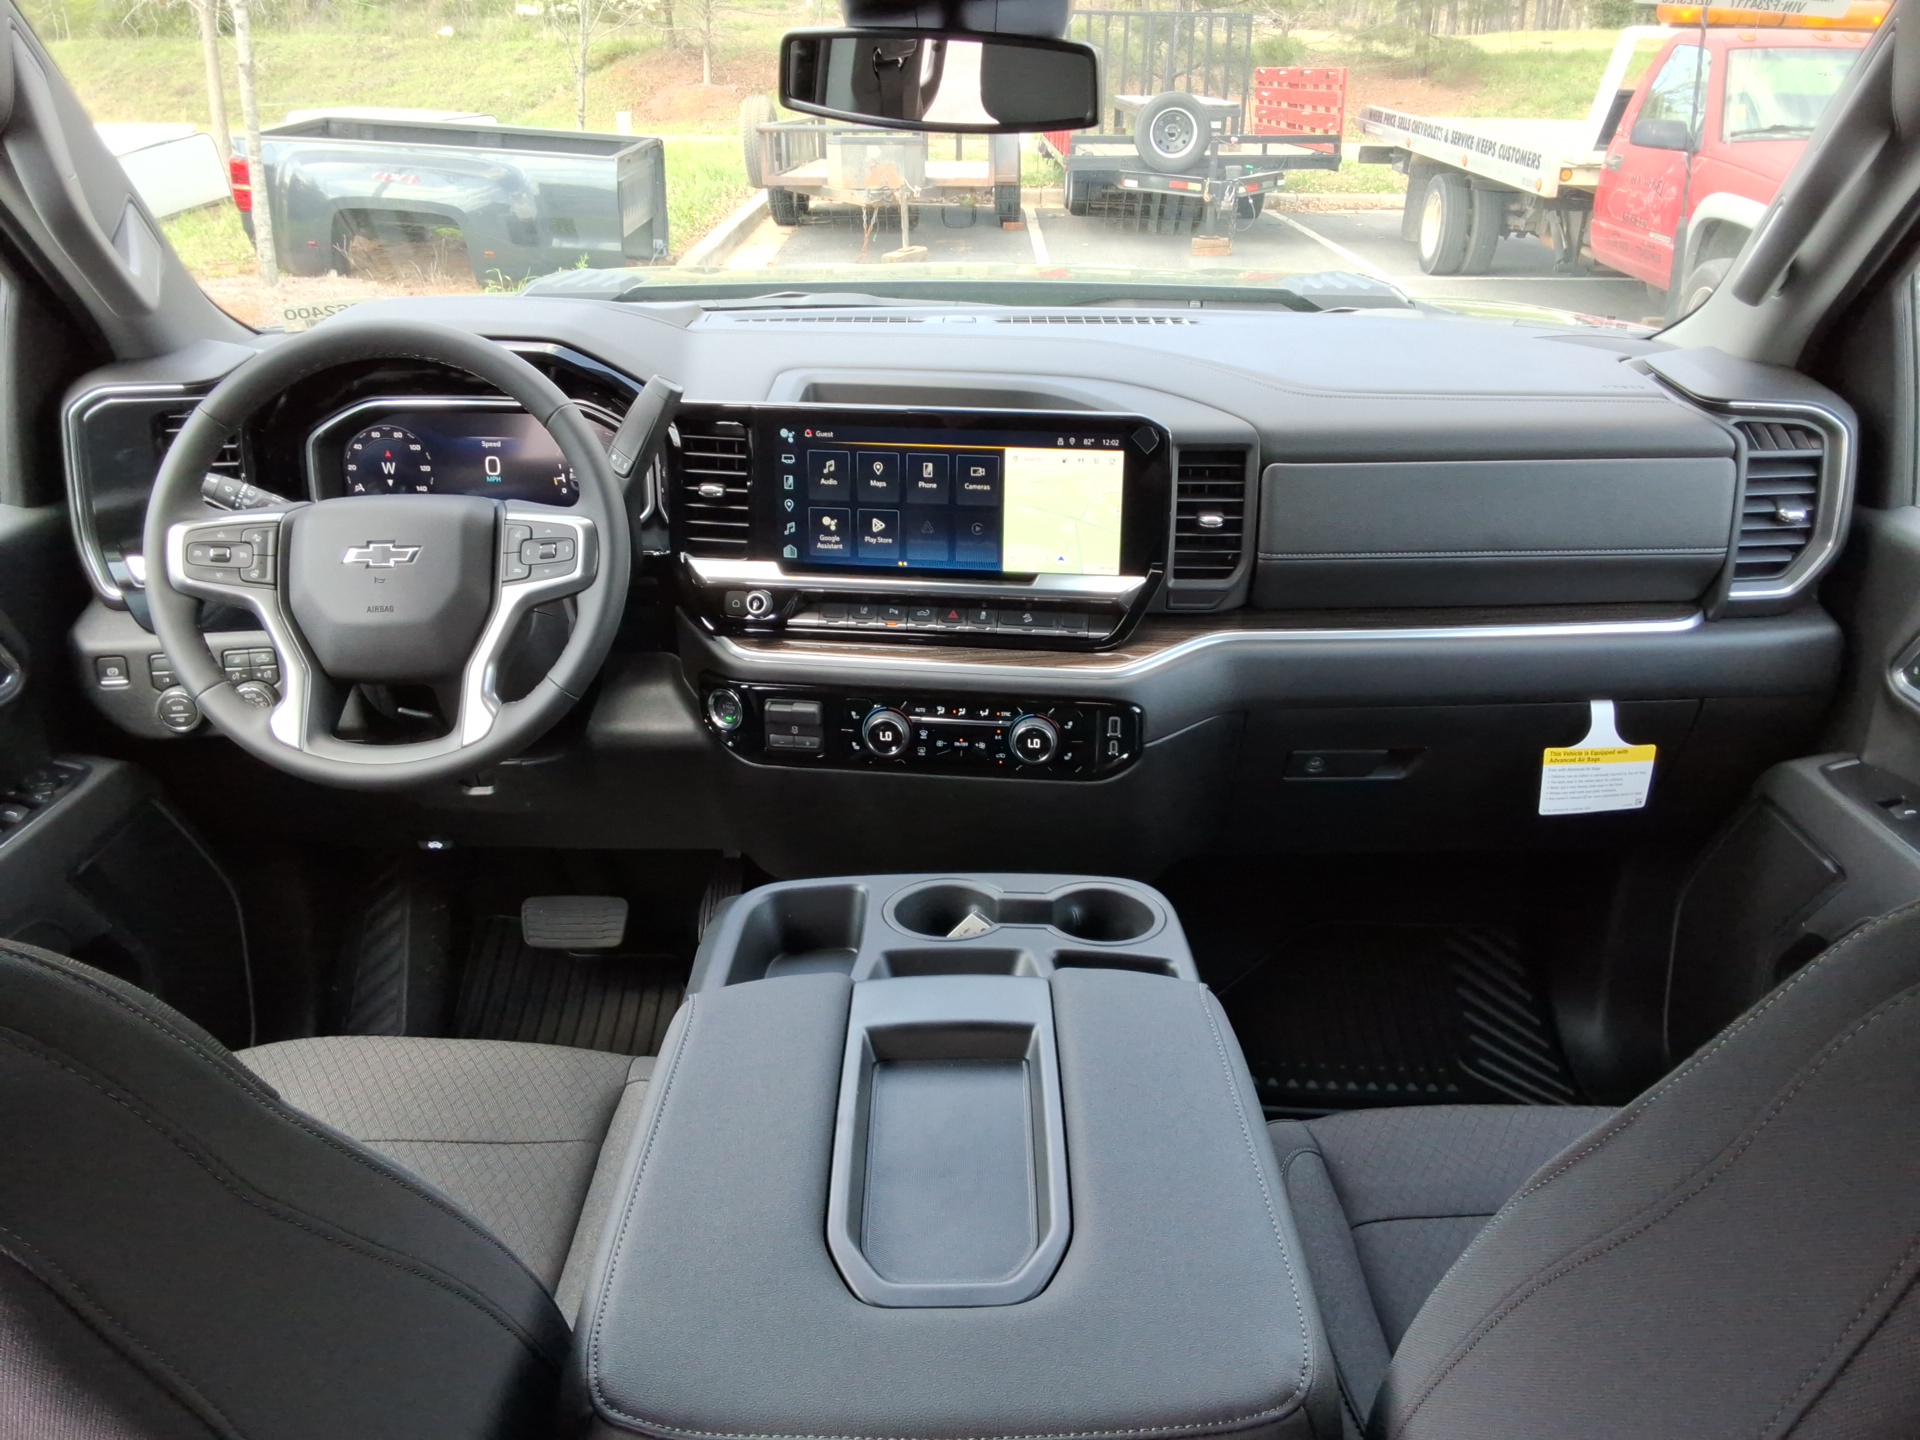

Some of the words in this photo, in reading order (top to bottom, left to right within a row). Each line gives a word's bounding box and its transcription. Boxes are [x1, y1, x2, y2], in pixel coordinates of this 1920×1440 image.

[1383, 112, 1397, 128] PRICE
[1397, 116, 1411, 132] SELLS
[1444, 128, 1450, 143] &
[1450, 129, 1475, 150] SERVICE
[1475, 136, 1498, 157] KEEPS
[1498, 143, 1542, 170] CUSTOMERS
[815, 430, 834, 438] Guest
[481, 440, 501, 449] Speed
[381, 461, 396, 475] W
[485, 456, 501, 476] 0
[870, 480, 887, 488] Maps
[918, 481, 937, 489] Phone
[964, 482, 991, 491] Cameras
[819, 534, 840, 543] Google
[864, 536, 877, 544] Play
[877, 536, 893, 544] Store
[1590, 749, 1616, 757] Equipped
